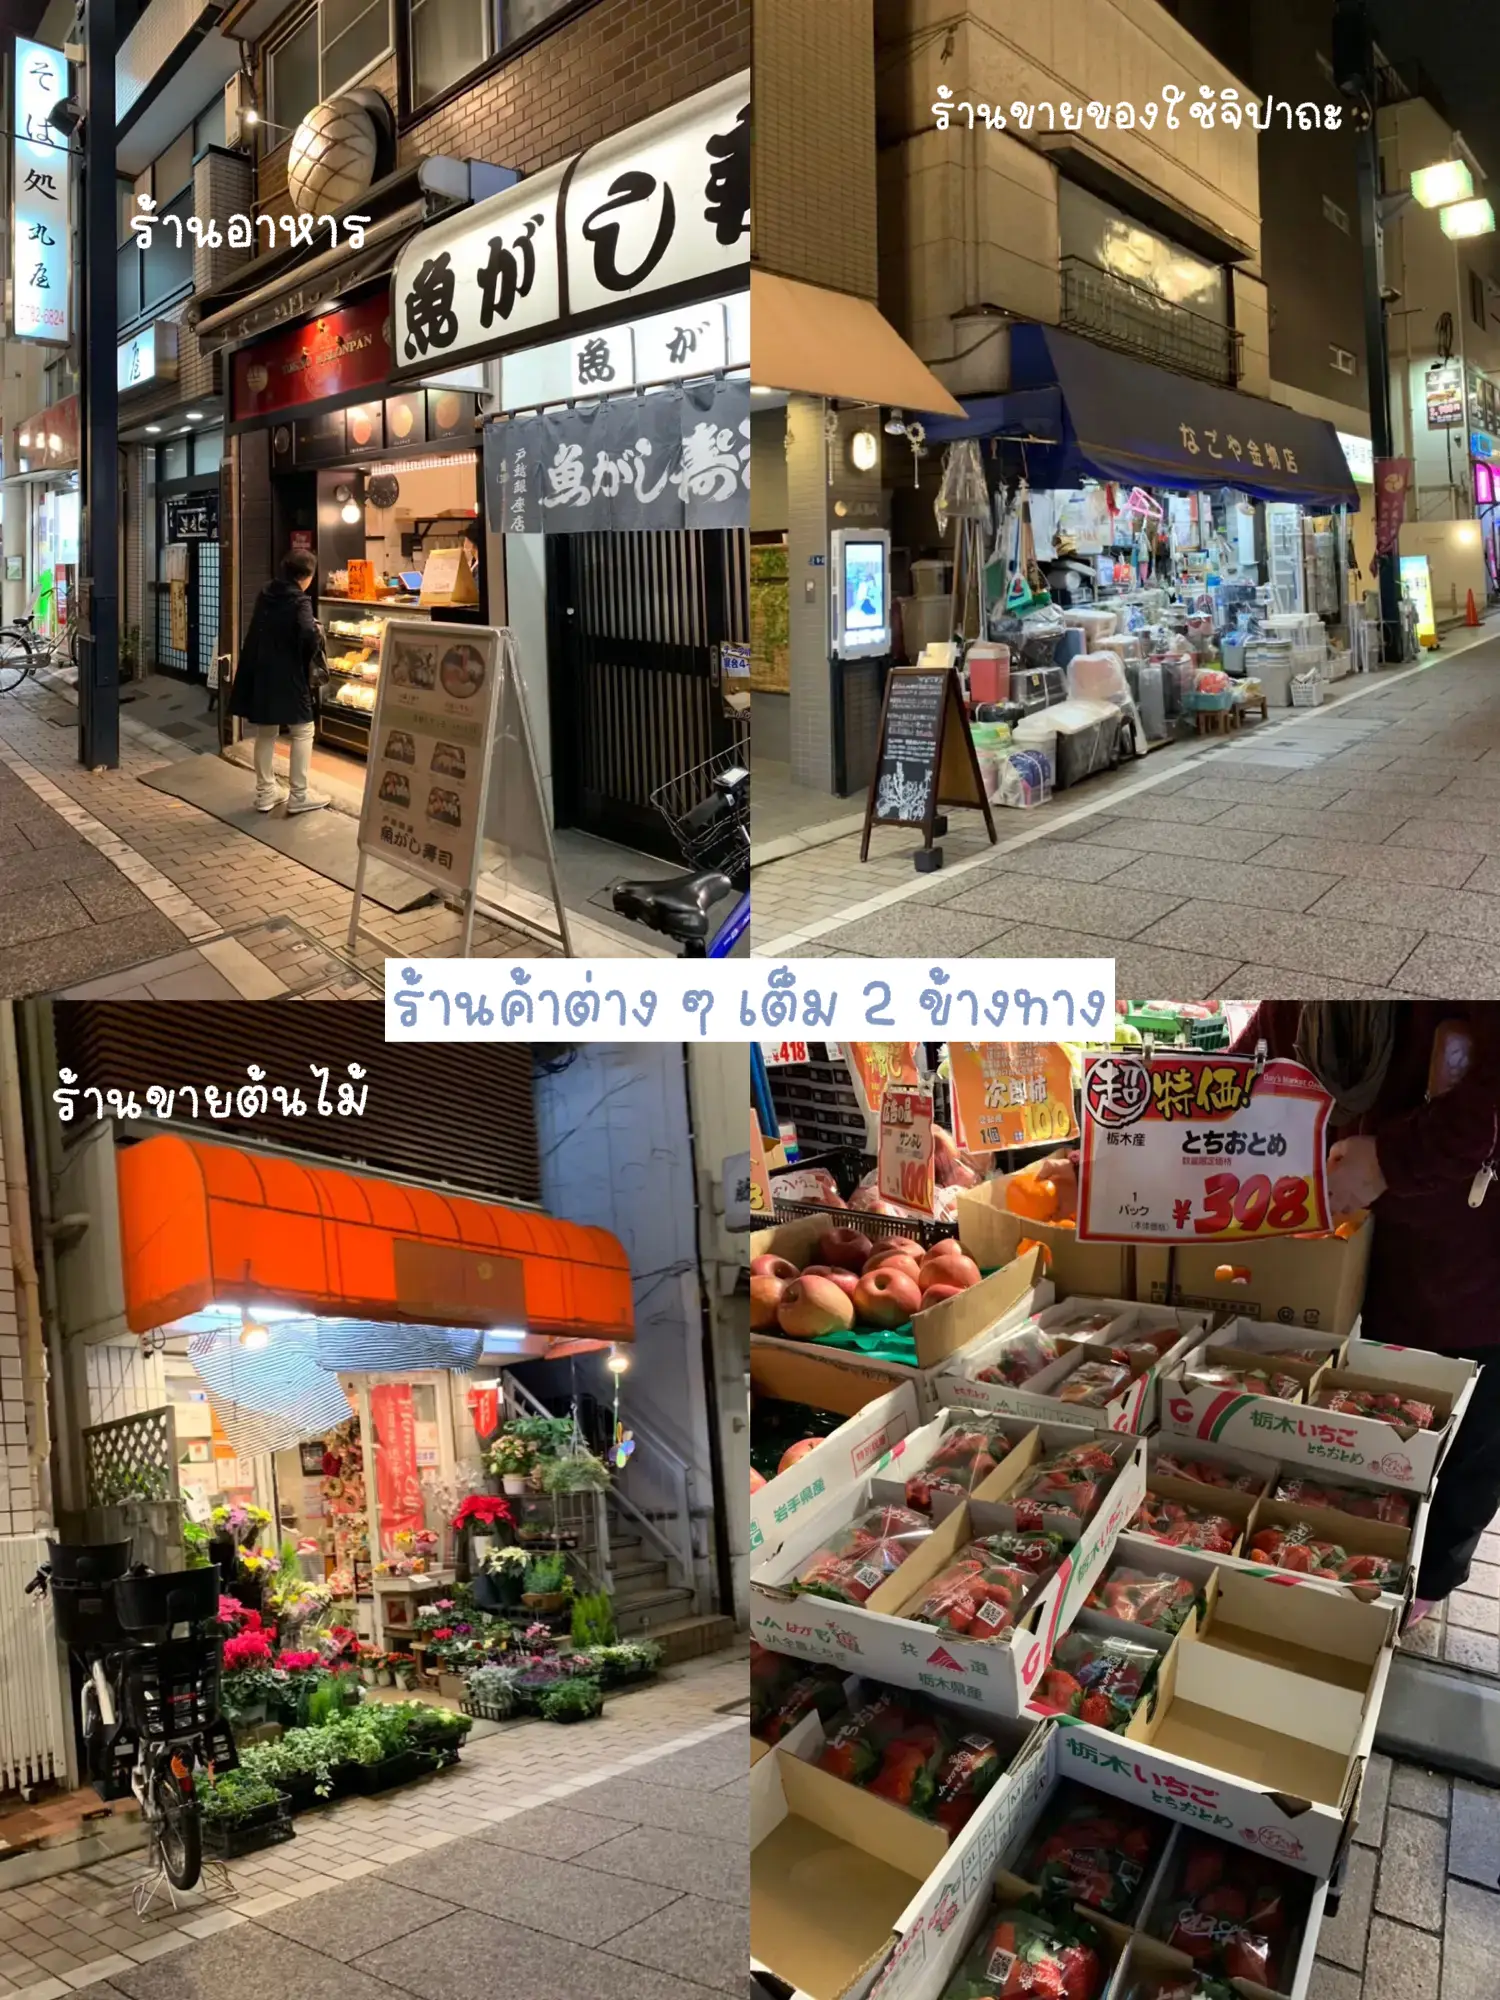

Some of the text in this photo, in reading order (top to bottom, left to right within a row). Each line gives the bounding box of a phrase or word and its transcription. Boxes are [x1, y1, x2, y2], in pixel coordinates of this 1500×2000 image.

[1106, 1131, 1146, 1147] 栃木産
[1182, 1130, 1287, 1157] とちおとめ
[1249, 1409, 1358, 1448] 栃木いちご
[1306, 1442, 1364, 1466] とちおとめ
[773, 1477, 826, 1525] 岩手県産
[918, 1673, 984, 1701] 栃木県産
[1066, 1737, 1220, 1809] 栃木いちご
[1151, 1790, 1234, 1829] とちおとめ
